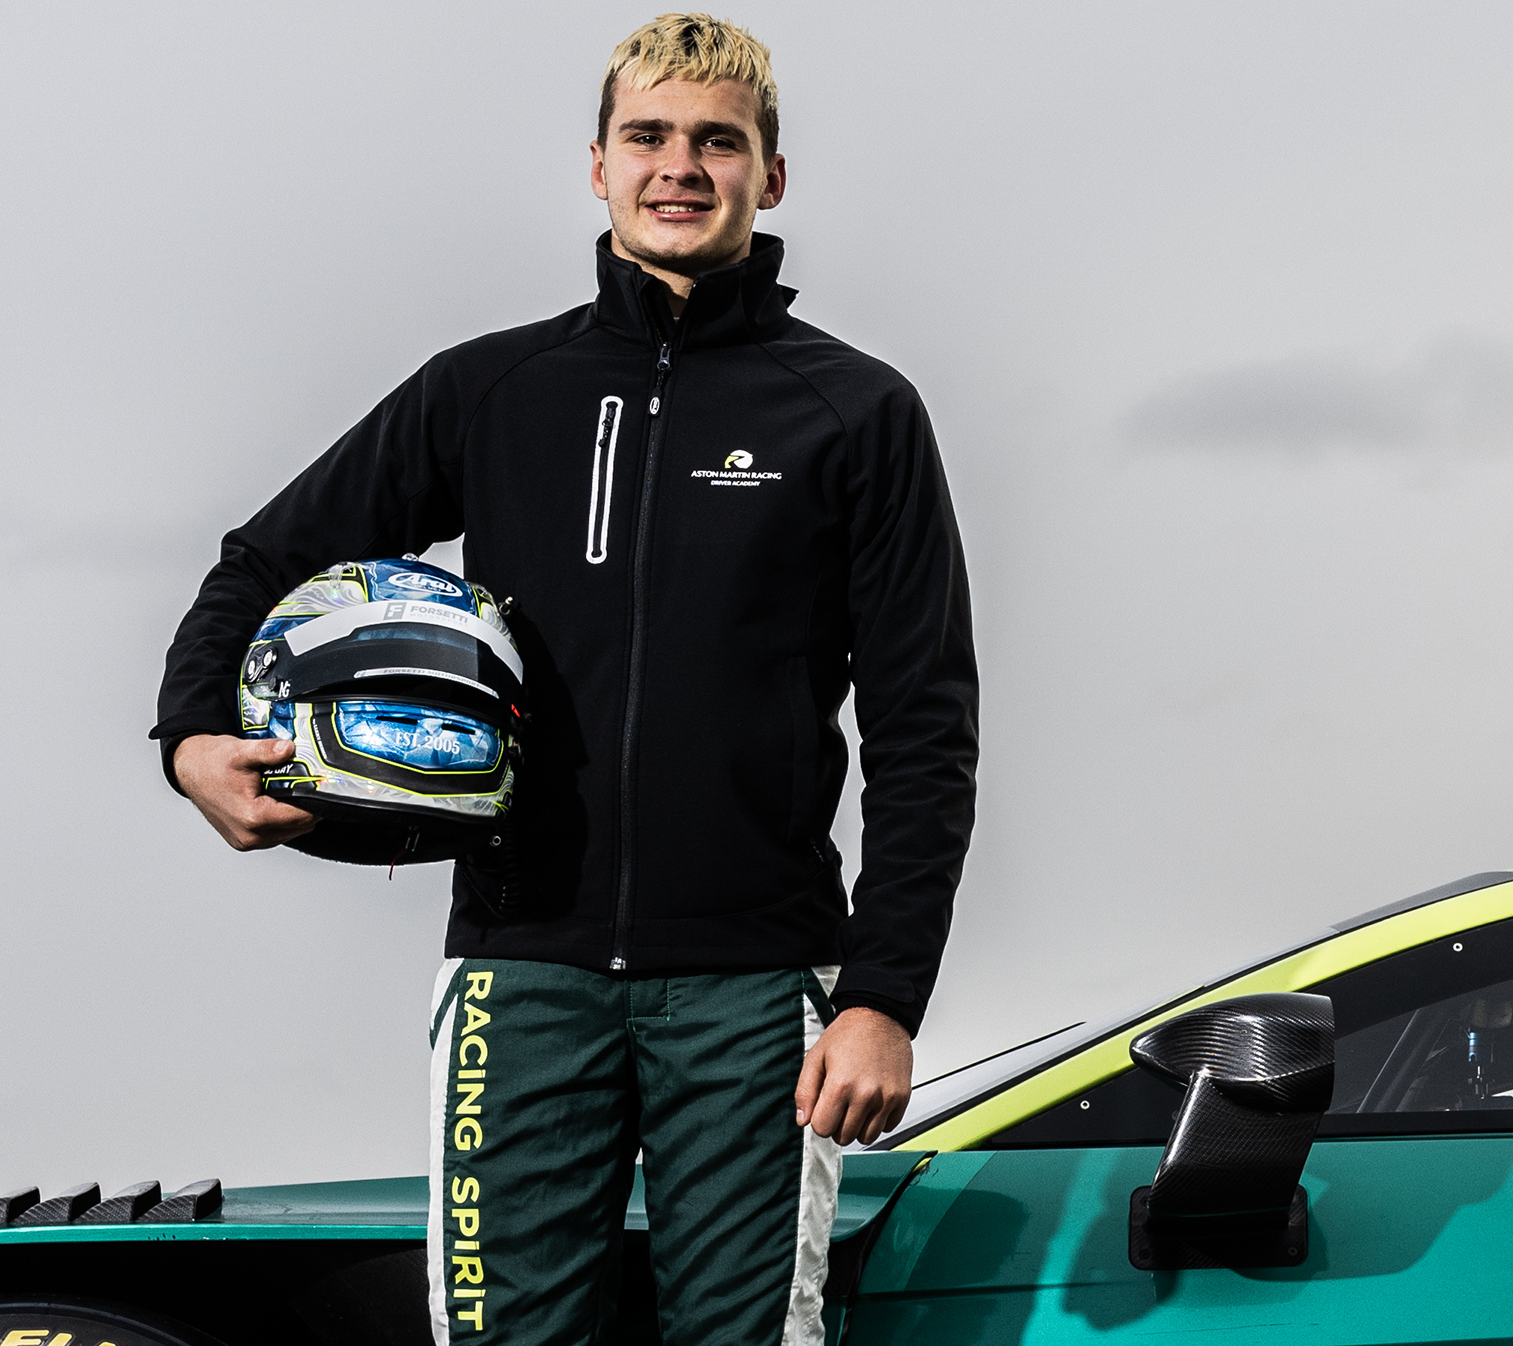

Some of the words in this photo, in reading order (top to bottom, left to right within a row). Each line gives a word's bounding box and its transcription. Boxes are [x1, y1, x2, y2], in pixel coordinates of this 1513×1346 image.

[690, 470, 718, 478] ASTON
[719, 471, 751, 479] MARTIN
[751, 472, 783, 480] RACING
[396, 574, 455, 593] Arai
[410, 606, 469, 624] FORSETTI
[396, 733, 420, 748] EST.
[424, 735, 460, 755] 2005
[454, 971, 494, 1151] RACING
[451, 1176, 487, 1331] SPIRIT
